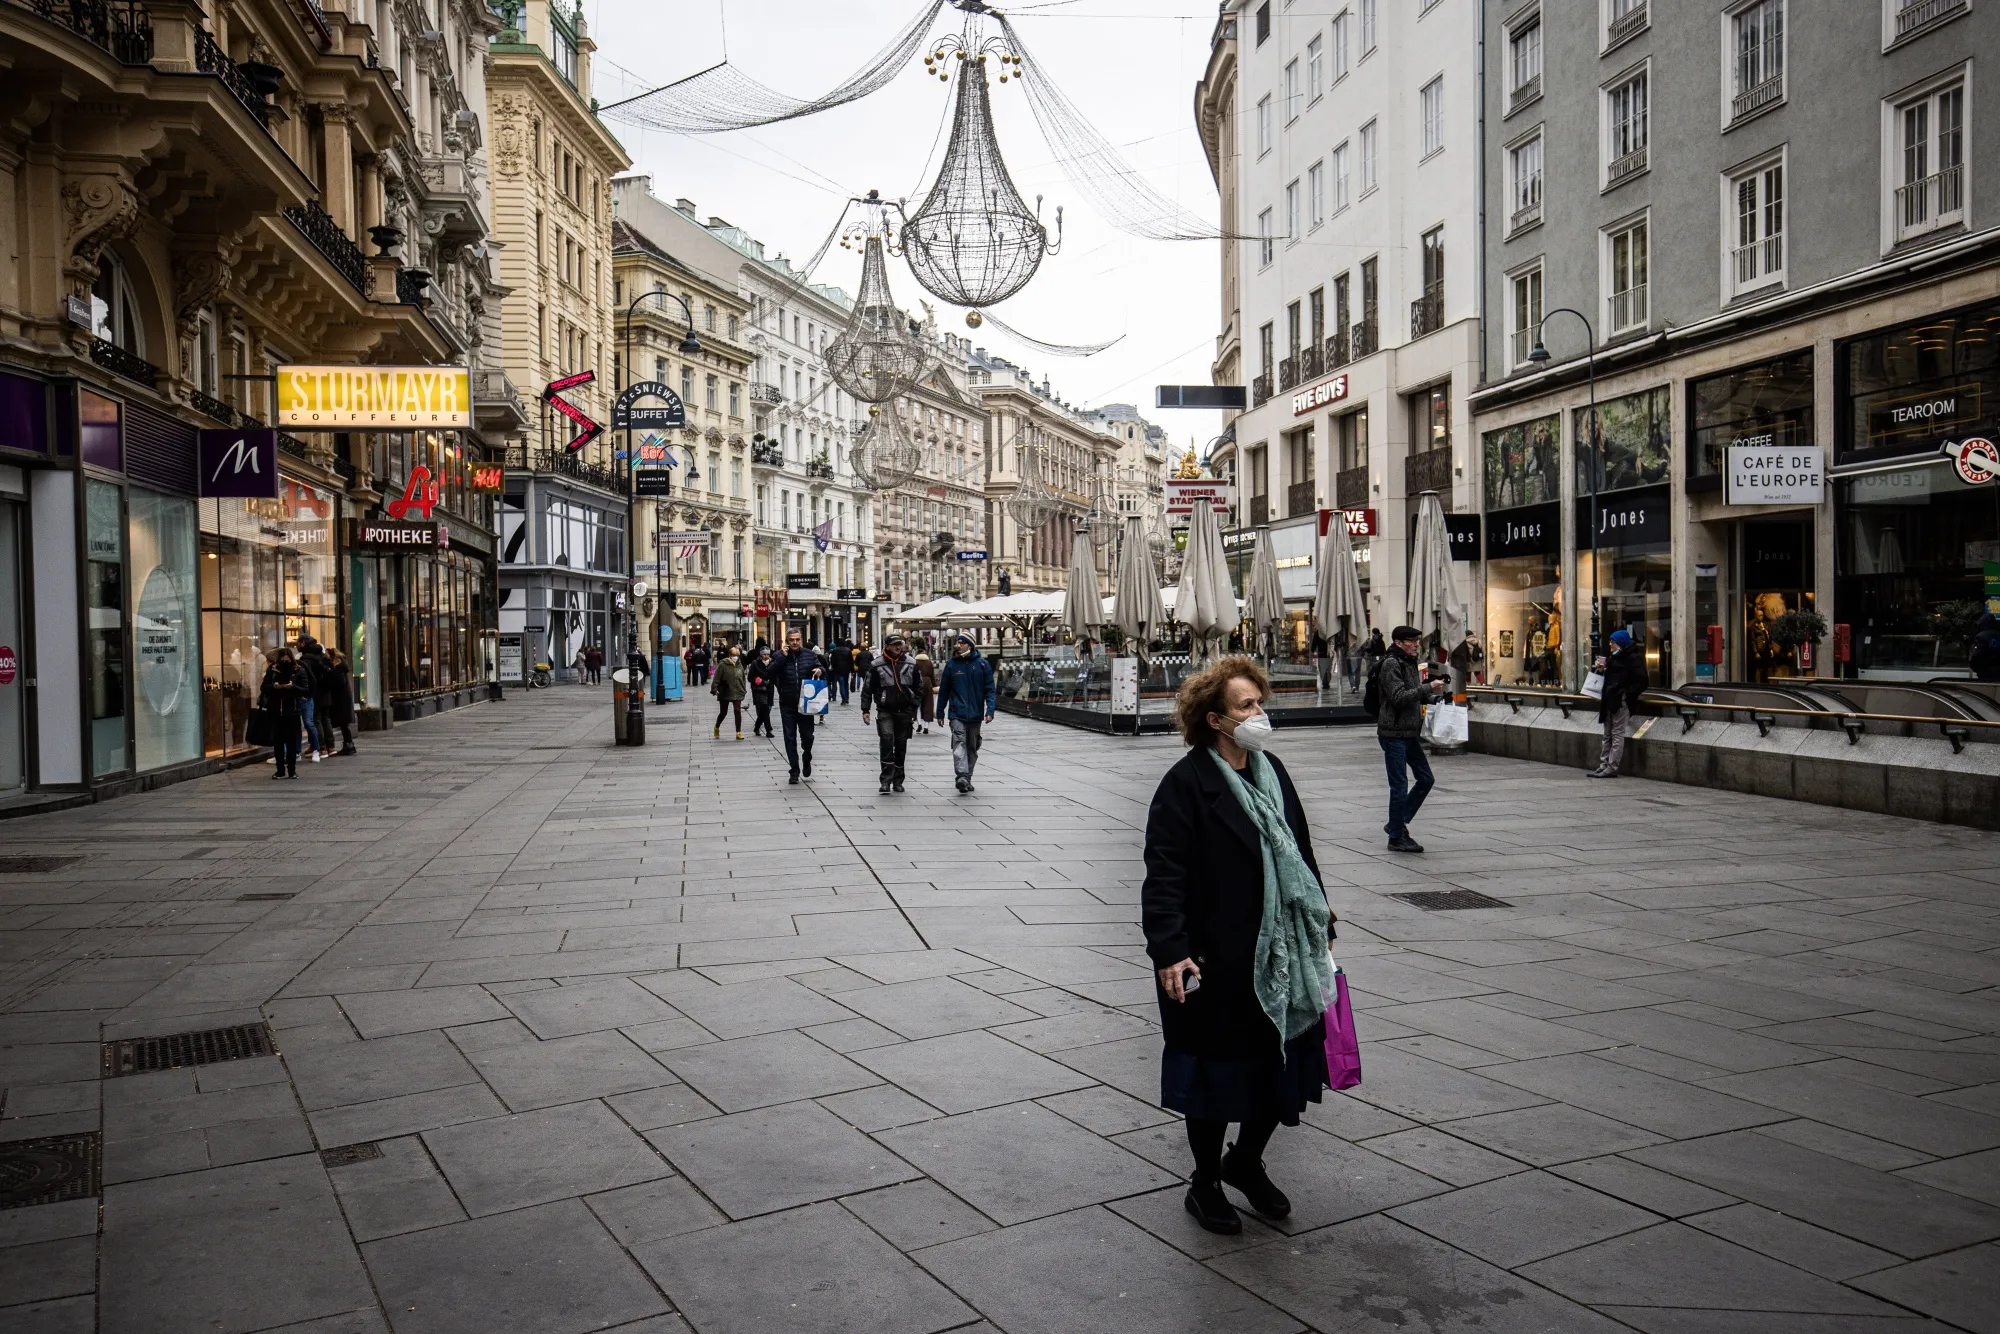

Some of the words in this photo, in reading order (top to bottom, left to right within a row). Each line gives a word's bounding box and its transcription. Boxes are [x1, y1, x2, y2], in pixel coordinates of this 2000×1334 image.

[290, 371, 457, 412] STURMAYR
[1293, 388, 1315, 414] FIVE
[1315, 377, 1345, 404] GUYS
[291, 413, 458, 422] COIFFEURE
[630, 410, 668, 418] BUFFET
[1892, 398, 1955, 422] TEAROOM
[1735, 434, 1772, 447] COFFEE
[1966, 442, 1996, 457] TABAK
[1744, 454, 1784, 468] CAFÉ
[1792, 456, 1812, 468] DE
[1962, 457, 1988, 480] TRAFIK
[1736, 474, 1819, 487] L'EUROPE
[1600, 508, 1645, 534] Jones
[366, 528, 432, 544] APOTHEKE
[1448, 532, 1474, 543] nes
[1505, 522, 1541, 545] Jones
